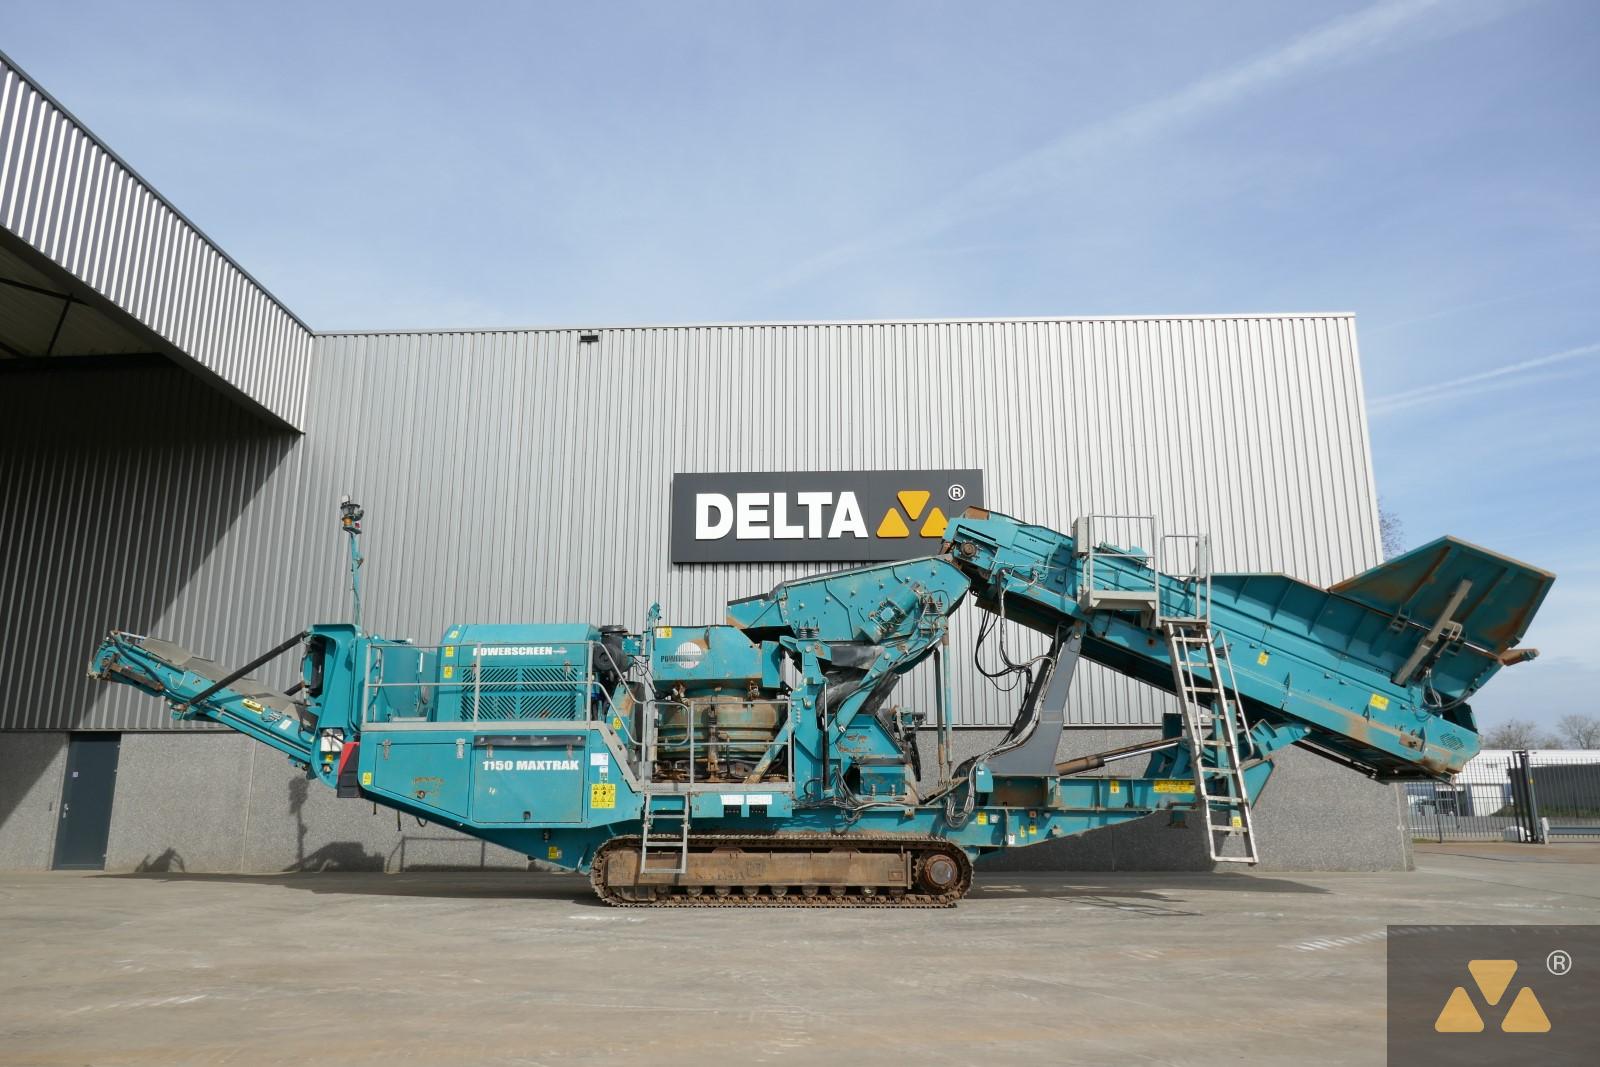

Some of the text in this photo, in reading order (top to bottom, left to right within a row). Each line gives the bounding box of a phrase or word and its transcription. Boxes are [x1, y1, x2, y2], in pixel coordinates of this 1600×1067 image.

[695, 491, 869, 539] DELTA
[472, 646, 553, 657] POWERSCREEN
[482, 760, 579, 771] 1150 MAXTRAK
